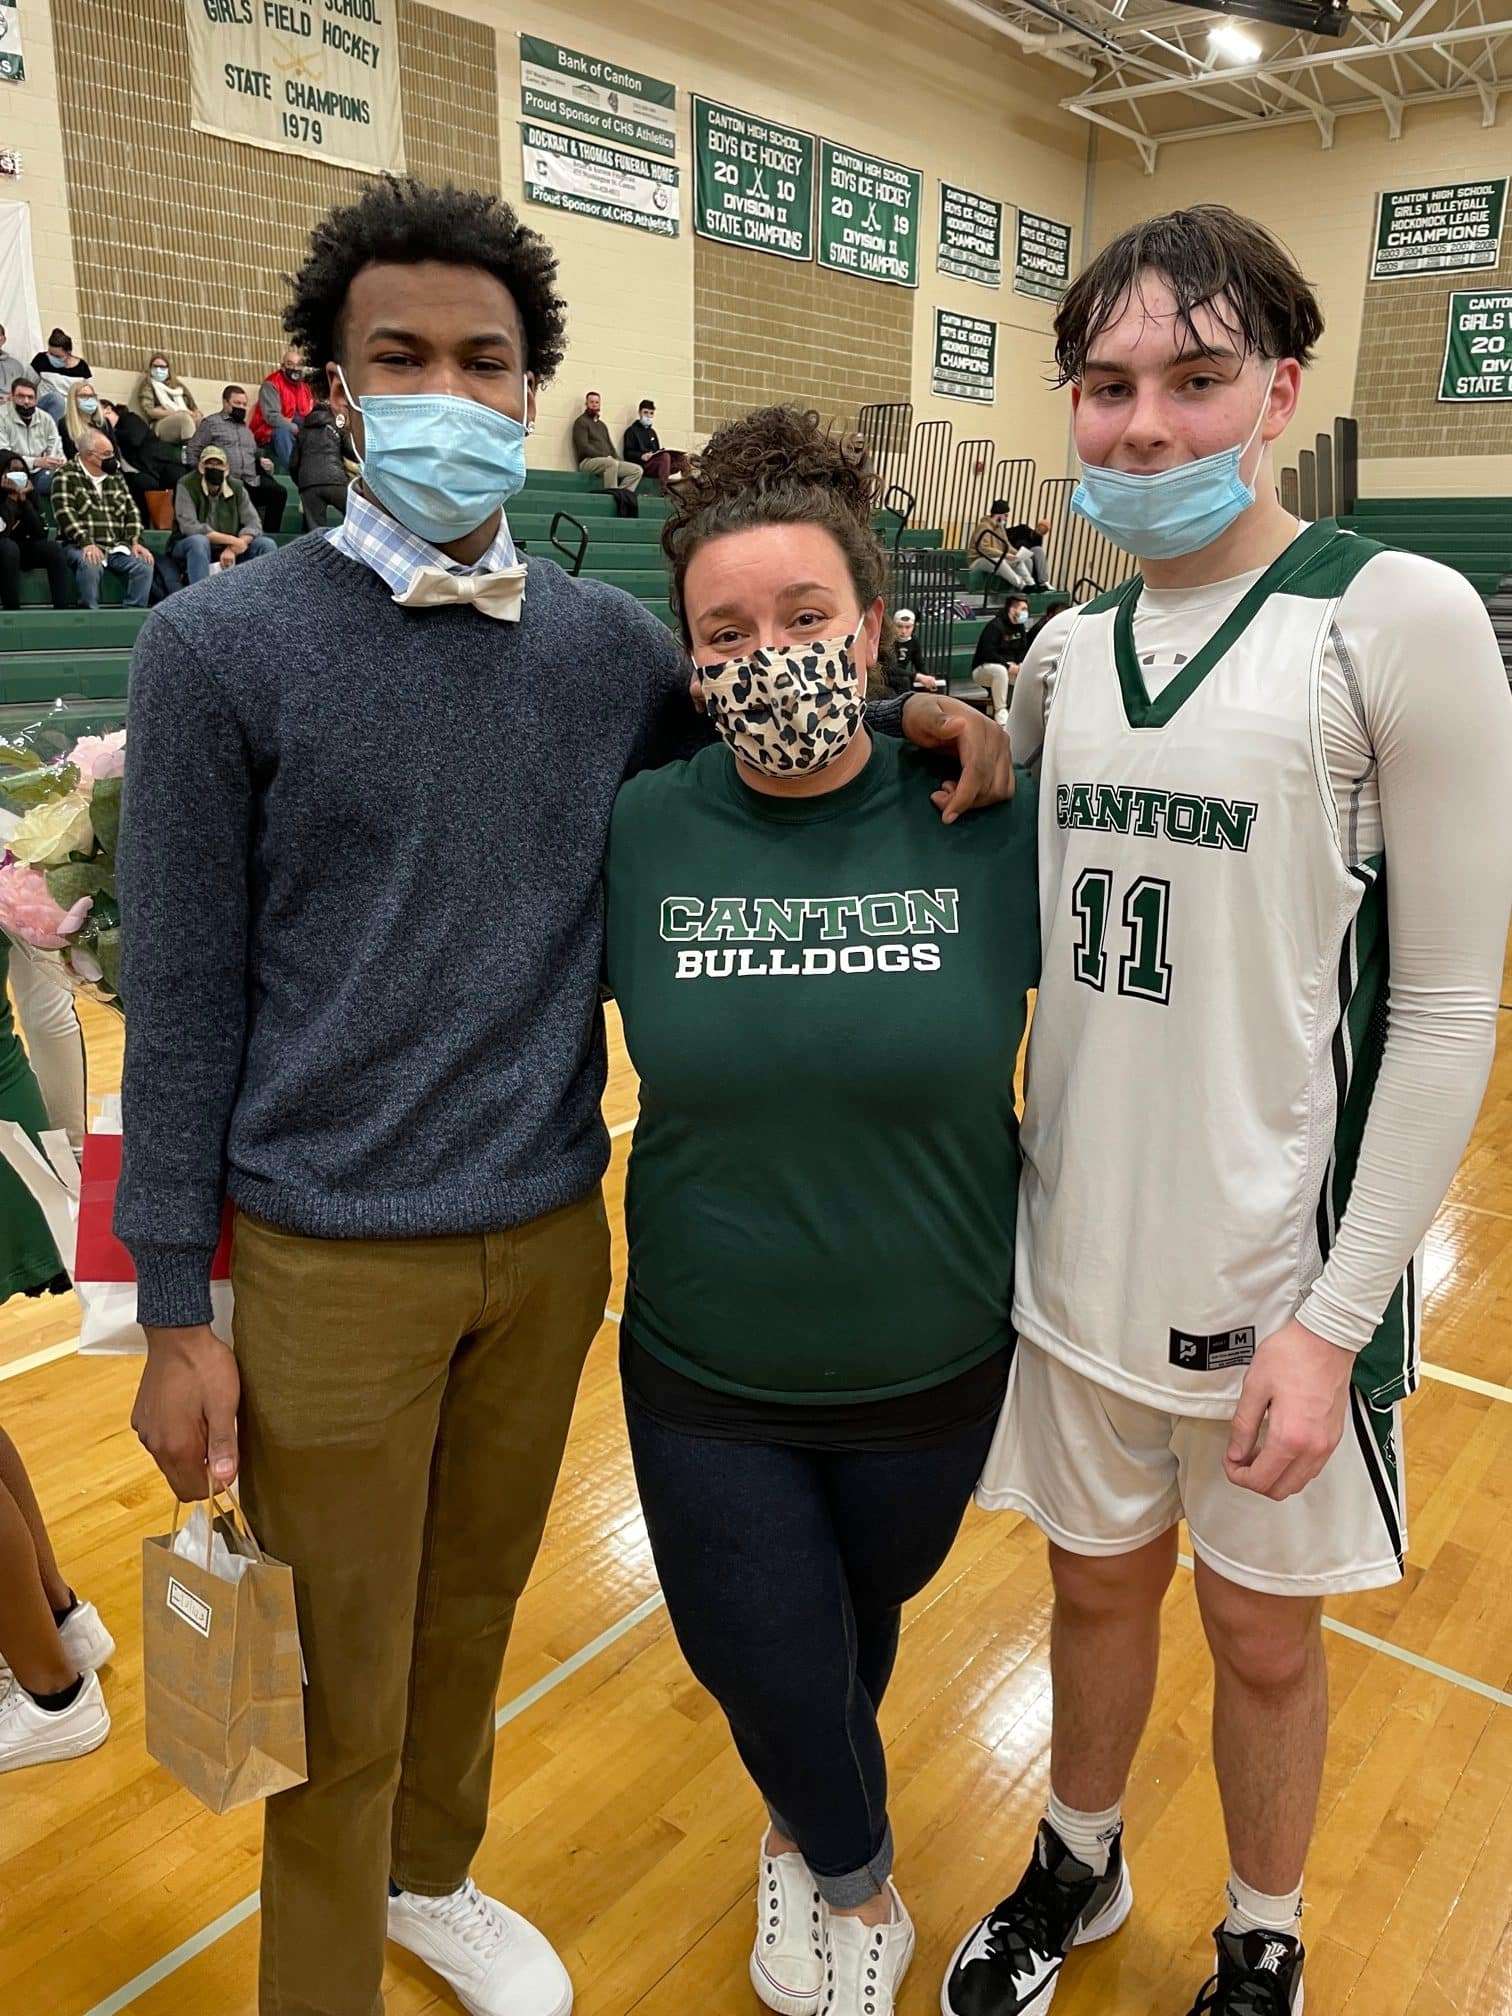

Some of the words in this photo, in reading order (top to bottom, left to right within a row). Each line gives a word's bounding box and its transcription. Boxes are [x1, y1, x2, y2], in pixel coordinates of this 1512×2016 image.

[205, 0, 253, 24] GIRLS
[264, 2, 311, 37] FIELD
[323, 19, 380, 69] HOCKEY
[558, 50, 587, 71] Bank
[590, 64, 601, 77] of
[604, 68, 642, 92] Canton
[225, 64, 272, 100] STATE
[285, 80, 370, 124] CHAMPIONS
[283, 112, 322, 144] 1979
[525, 92, 557, 112] Proud
[559, 102, 599, 126] Sponsor
[602, 116, 613, 130] of
[614, 120, 634, 137] CHS
[636, 126, 673, 149] Athletics
[708, 110, 744, 134] CANTON
[747, 124, 767, 141] HIGH
[769, 130, 802, 152] SCHOOL
[571, 142, 578, 156] &
[580, 143, 614, 167] THOMAS
[615, 156, 650, 176] FUNERAL
[650, 167, 673, 182] HOME
[708, 129, 738, 157] BOYS
[741, 139, 757, 163] ICE
[760, 146, 802, 176] HOCKEY
[833, 151, 863, 173] CANTON
[864, 163, 881, 178] HIGH
[883, 168, 911, 188] SCHOOL
[714, 161, 738, 186] 20
[777, 179, 795, 201] 10
[831, 167, 856, 192] BOYS
[858, 177, 873, 198] ICE
[876, 182, 911, 208] HOCKEY
[1391, 192, 1428, 206] CANTON
[1431, 189, 1453, 201] HIGH
[1457, 185, 1495, 198] SCHOOL
[533, 185, 560, 204] Proud
[562, 193, 600, 216] Sponsor
[613, 207, 634, 222] CHS
[635, 214, 673, 235] Athletics
[724, 193, 774, 219] DIVISION
[832, 197, 853, 218] 20
[893, 215, 909, 235] 19
[1391, 214, 1447, 231] HOCKOMOCK
[1449, 210, 1490, 225] LEAGUE
[1394, 204, 1422, 218] GIRLS
[1426, 197, 1488, 215] VOLLEYBALL
[706, 209, 741, 236] STATE
[745, 218, 802, 251] CHAMPIONS
[843, 228, 886, 252] DIVISION
[946, 230, 995, 256] CHAMPIONS
[1387, 224, 1490, 246] CHAMPIONS
[830, 242, 858, 266] STATE
[860, 250, 908, 278] CHAMPIONS
[1021, 253, 1065, 276] CHAMPIONS
[1459, 312, 1504, 331] GIRLS
[1471, 336, 1505, 353] 20
[940, 352, 989, 374] CHAMPIONS
[1456, 375, 1505, 393] STATE
[1057, 783, 1259, 853] CANTON
[660, 888, 959, 942] CANTON
[1072, 867, 1173, 1006] 11
[675, 943, 941, 979] BULLDOGS
[1235, 1333, 1247, 1345] M
